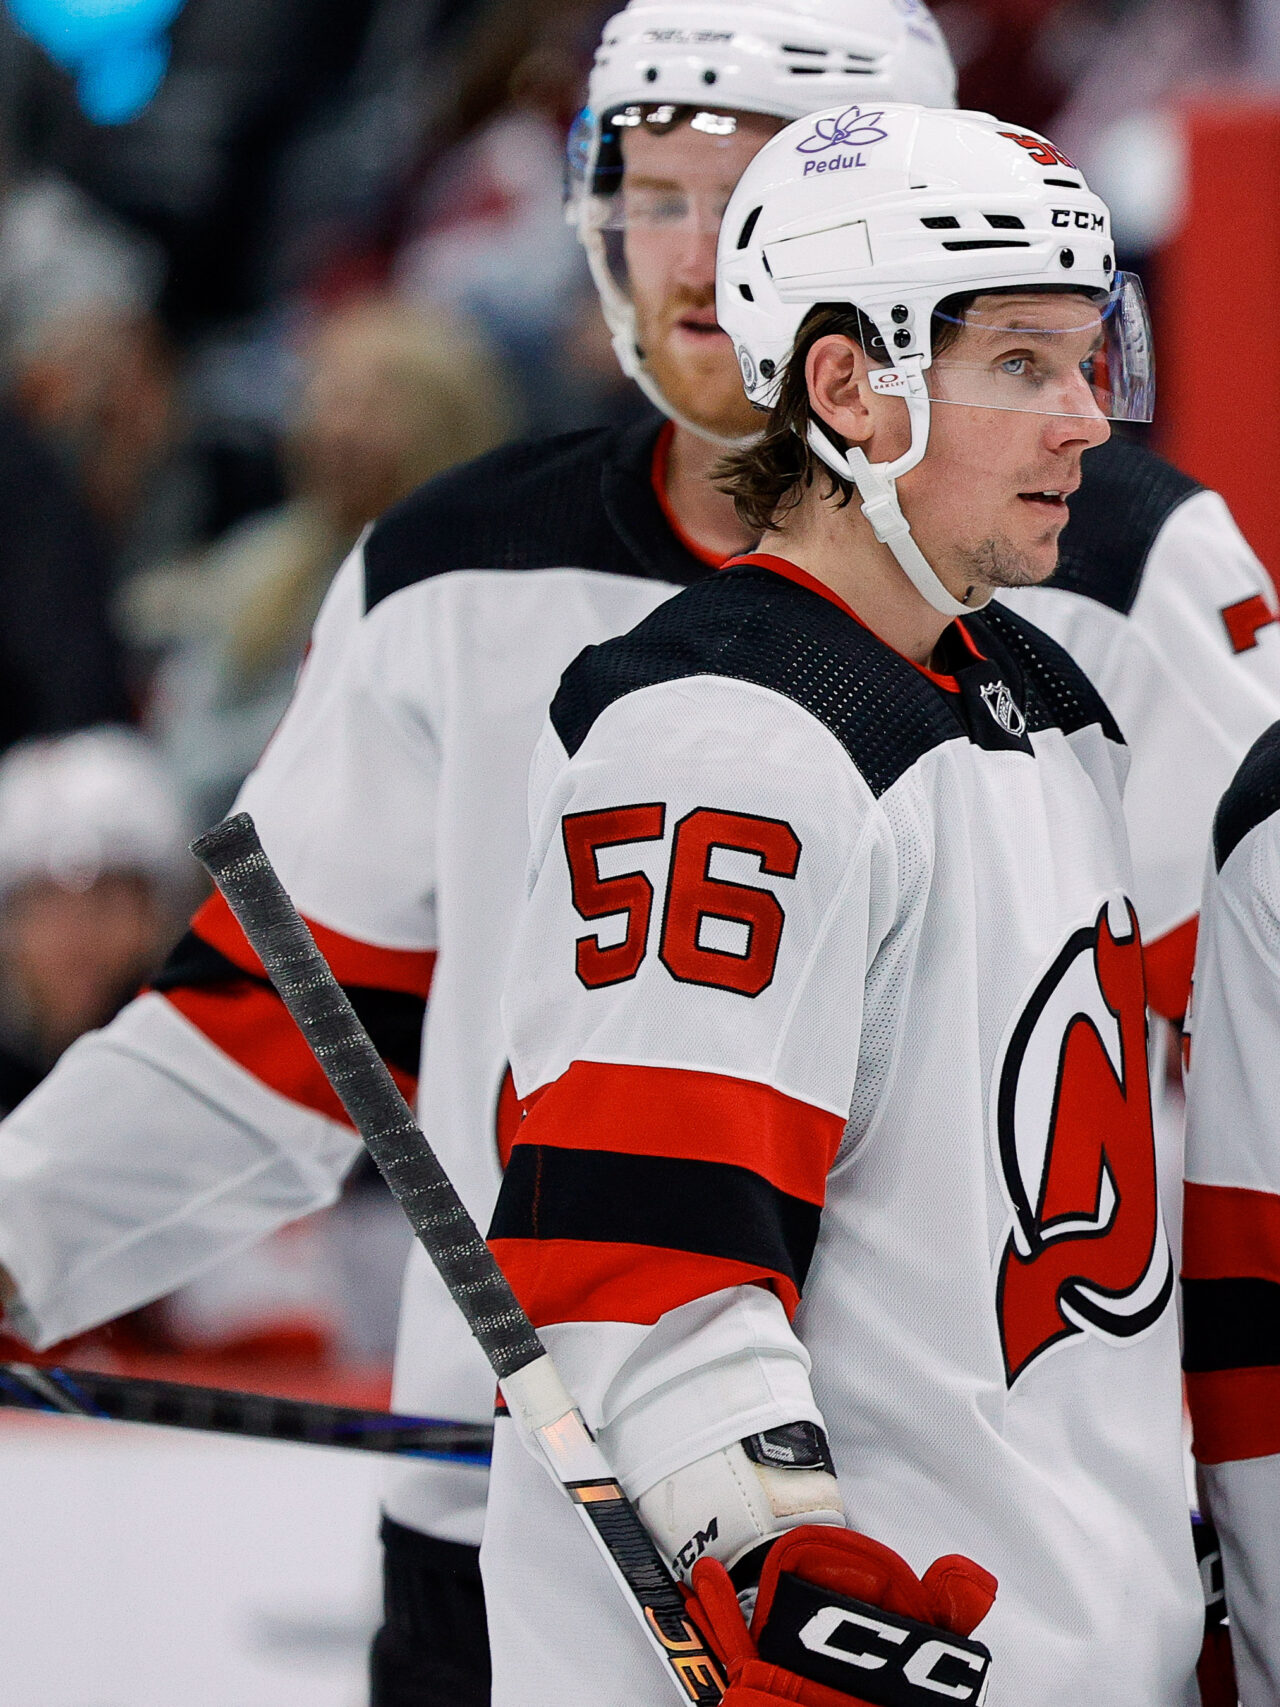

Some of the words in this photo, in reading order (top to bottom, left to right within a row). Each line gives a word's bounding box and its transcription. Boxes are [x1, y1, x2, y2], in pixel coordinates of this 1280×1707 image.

[803, 152, 866, 176] PeduL
[1051, 209, 1104, 232] CCM
[562, 802, 801, 998] 56
[799, 1606, 992, 1707] CC
